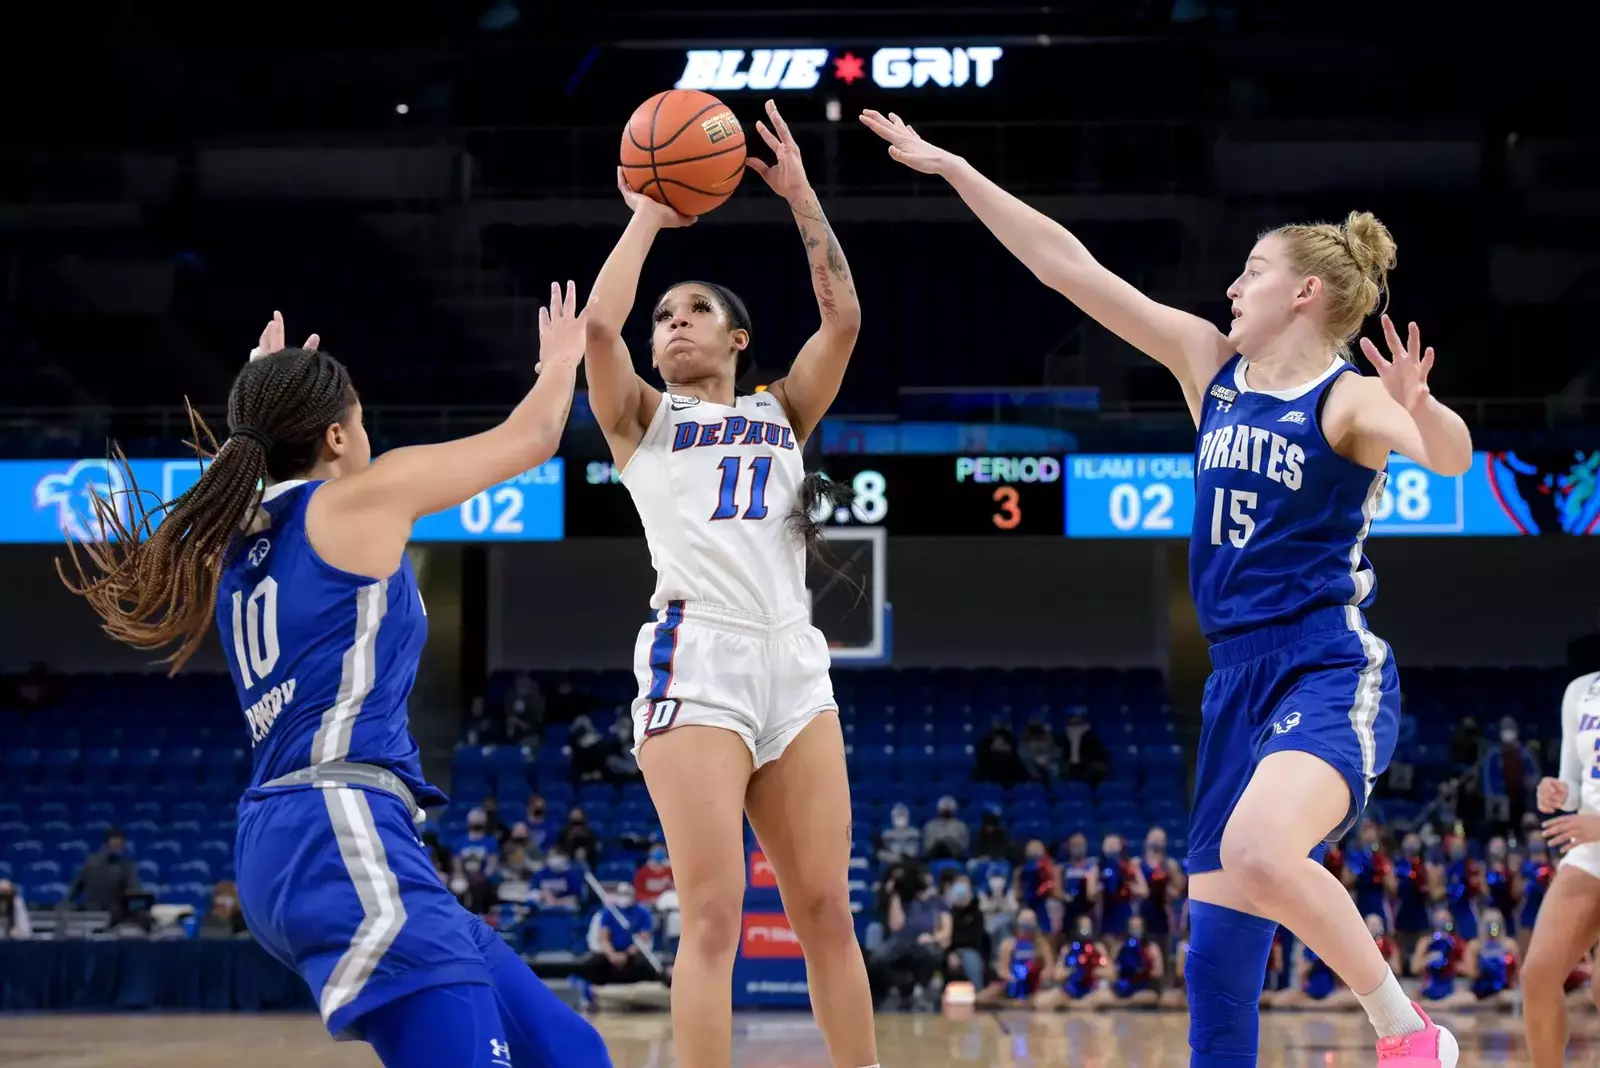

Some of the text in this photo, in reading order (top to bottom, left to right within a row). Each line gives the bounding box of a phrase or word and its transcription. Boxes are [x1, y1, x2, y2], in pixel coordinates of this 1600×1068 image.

[674, 47, 1003, 90] BLUE GRIT
[956, 456, 1060, 483] PERIOD
[1137, 457, 1195, 480] FOUL
[1197, 424, 1306, 492] PIRATES
[460, 487, 524, 534] 02
[708, 456, 773, 521] 11
[992, 486, 1022, 530] 3
[1109, 482, 1174, 531] 02
[1211, 487, 1258, 548] 15
[232, 575, 280, 690] 10
[644, 698, 683, 737] D
